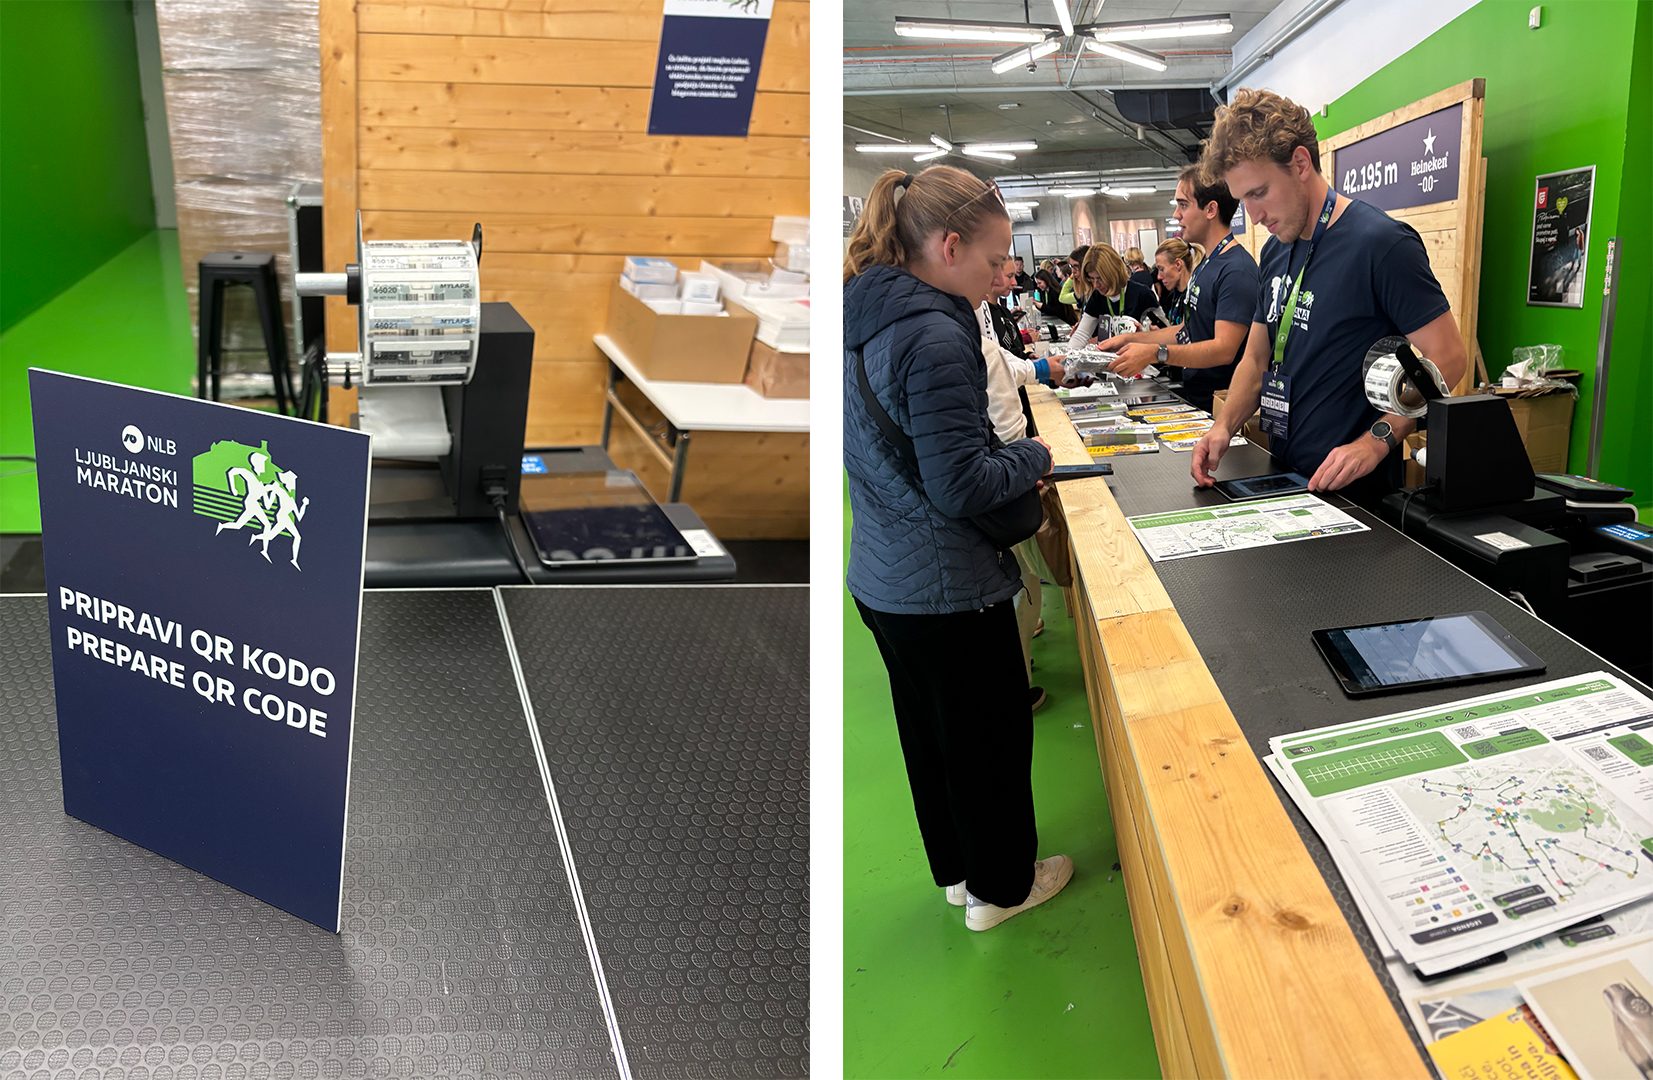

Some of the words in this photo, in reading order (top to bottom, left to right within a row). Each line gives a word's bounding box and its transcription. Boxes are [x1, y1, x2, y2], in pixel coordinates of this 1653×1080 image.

[1343, 160, 1382, 194] 42.195
[1384, 162, 1398, 186] m
[147, 436, 177, 456] NLB
[75, 448, 178, 486] LJUBLJANSKI
[77, 466, 178, 509] MARATON
[59, 586, 183, 648] PRIPRAVI
[190, 629, 234, 666] QR
[242, 644, 336, 696] KODO
[67, 626, 185, 689] PREPARE
[192, 671, 236, 706] QR
[243, 688, 328, 738] CODE
[1507, 1045, 1523, 1061] in
